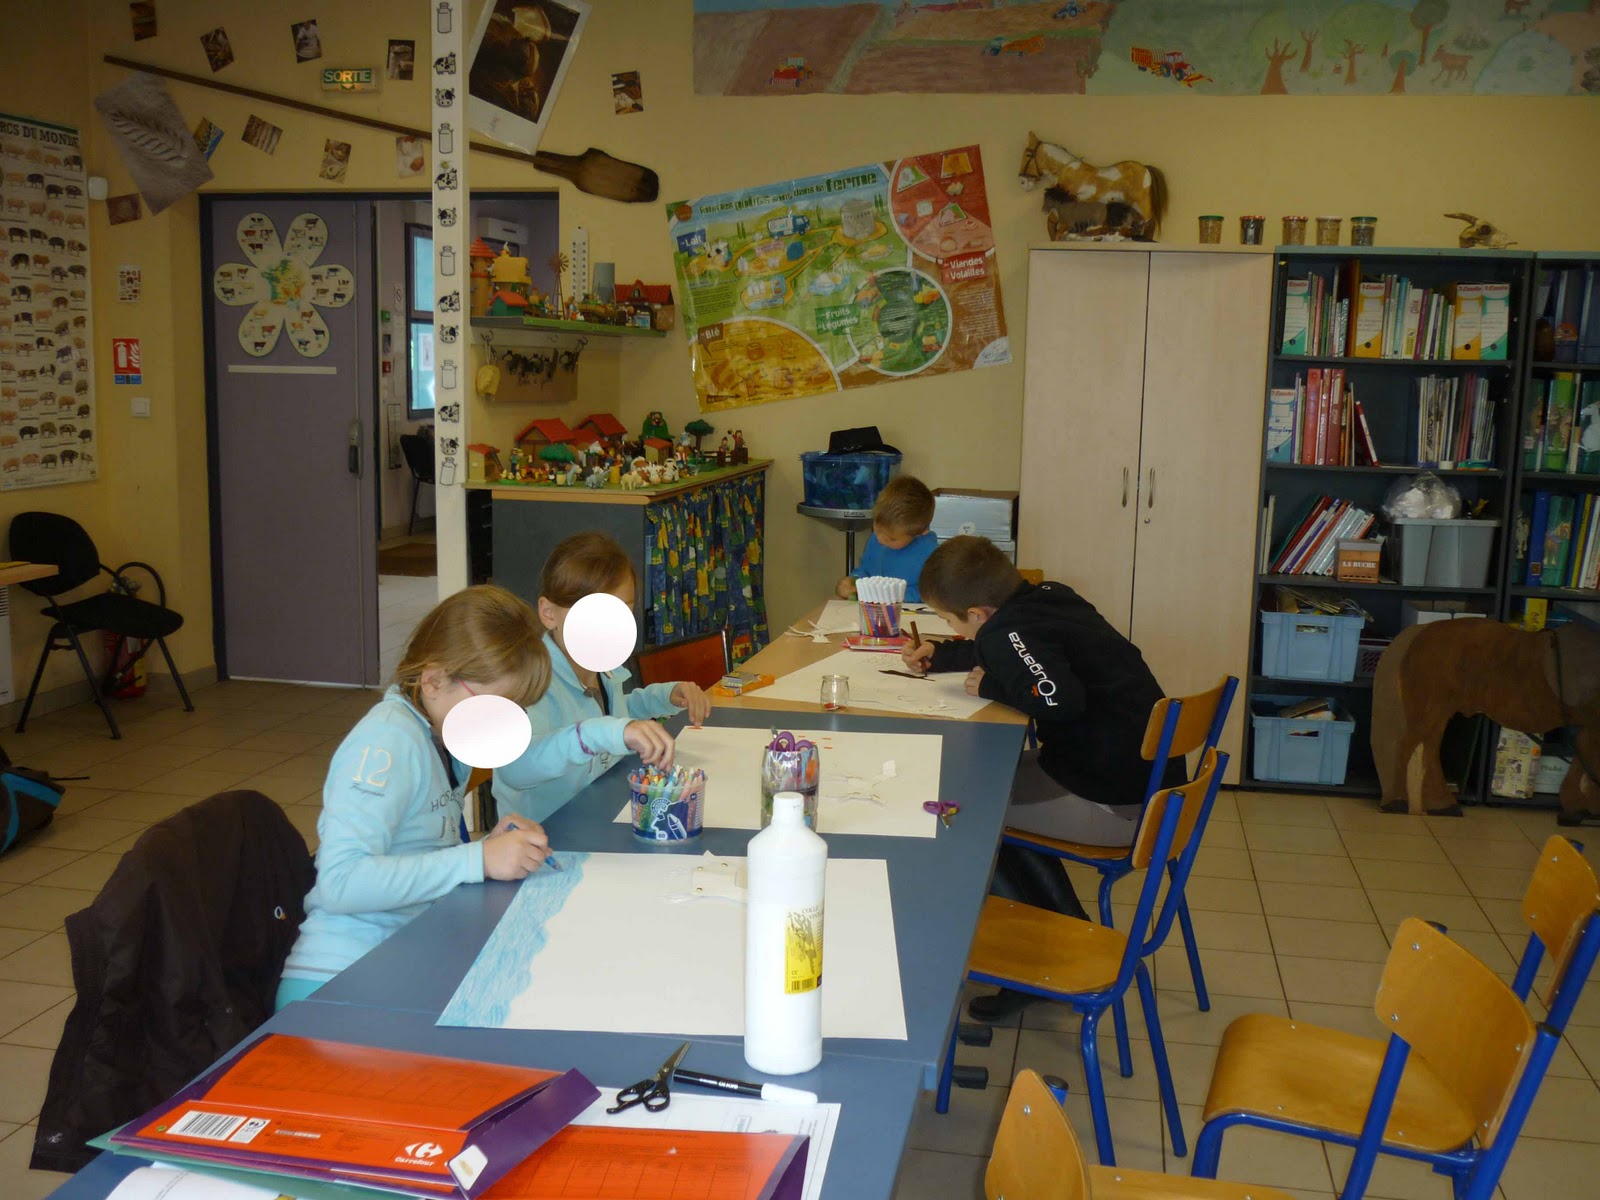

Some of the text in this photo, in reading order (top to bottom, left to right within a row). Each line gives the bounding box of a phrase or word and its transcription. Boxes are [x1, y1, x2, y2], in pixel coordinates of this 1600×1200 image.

[324, 70, 371, 82] SORTIE
[22, 126, 37, 139] DU
[39, 129, 79, 146] MONDE
[826, 171, 878, 193] ferme
[684, 234, 702, 247] Lait
[950, 257, 984, 268] Viandes
[950, 268, 985, 280] Volailles
[825, 307, 851, 320] Fruits
[822, 316, 859, 331] Légumes
[705, 326, 721, 339] Blé
[1008, 631, 1059, 707] Fouganza
[352, 744, 393, 787] 12
[394, 1157, 435, 1167] Carrefour
